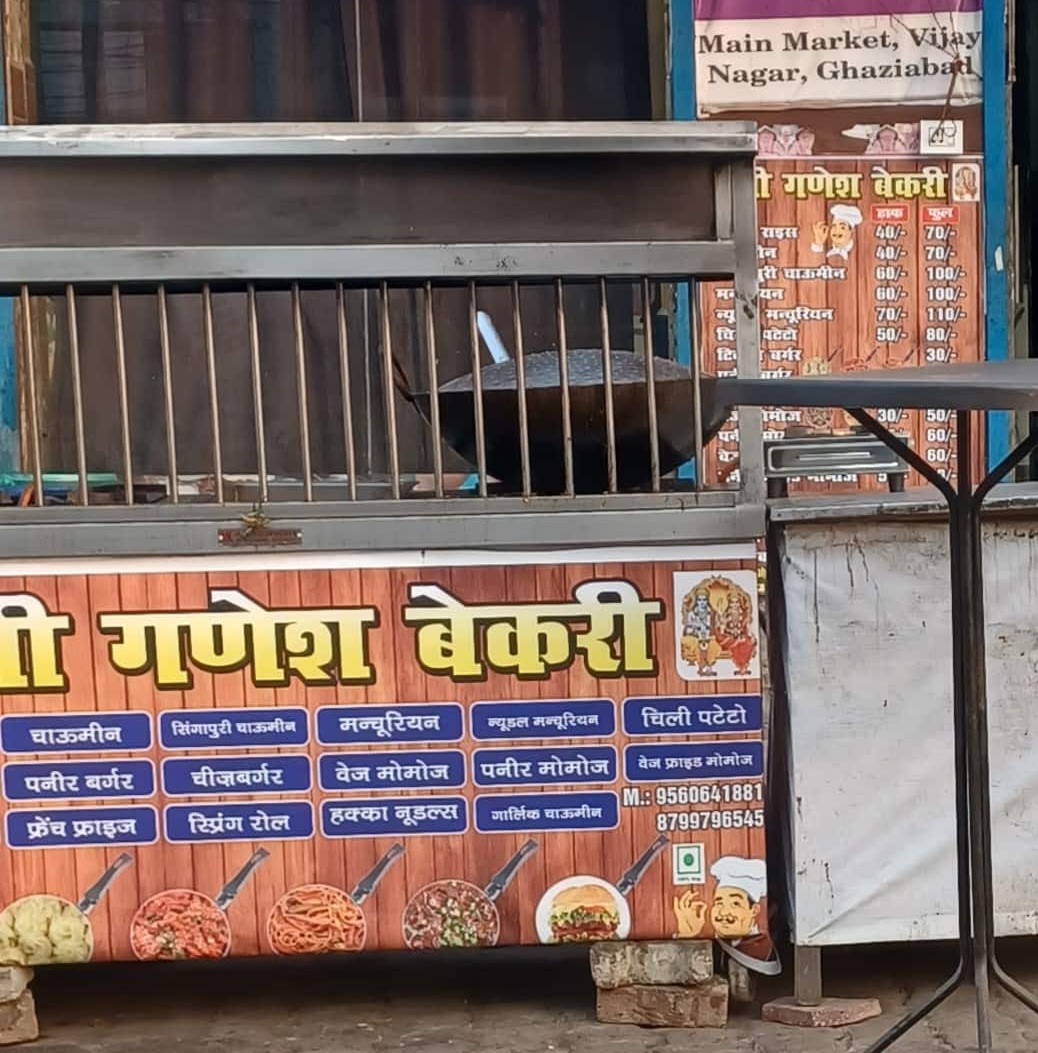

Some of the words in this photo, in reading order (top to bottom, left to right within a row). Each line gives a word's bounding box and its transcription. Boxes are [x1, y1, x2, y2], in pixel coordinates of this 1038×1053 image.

[698, 34, 773, 54] Main
[782, 30, 899, 52] Market,
[908, 27, 982, 51] Vijay
[707, 63, 808, 87] Nagar,
[816, 56, 973, 80] Ghaziabad
[781, 166, 864, 198] गणेश
[871, 165, 949, 198] बेकरी
[98, 588, 378, 688] गणेश
[403, 580, 664, 681] बेकरी
[641, 706, 692, 729] चिली
[697, 703, 747, 725] पटेटो
[29, 722, 122, 745] चाऊमीन
[335, 761, 371, 783] वेज
[376, 758, 449, 782] मोमोज
[480, 757, 533, 779] पनीर
[537, 754, 610, 777] मोमोज
[24, 770, 80, 793] पनीर
[84, 767, 134, 791] बर्गर
[655, 782, 764, 805] 9560641881
[26, 815, 67, 840] फ्रेंच
[72, 818, 137, 840] फ्राइज
[249, 809, 291, 832] रोल
[329, 806, 388, 826] हक्का
[394, 804, 459, 827] नूडल्स
[656, 809, 765, 832] 8799796545
